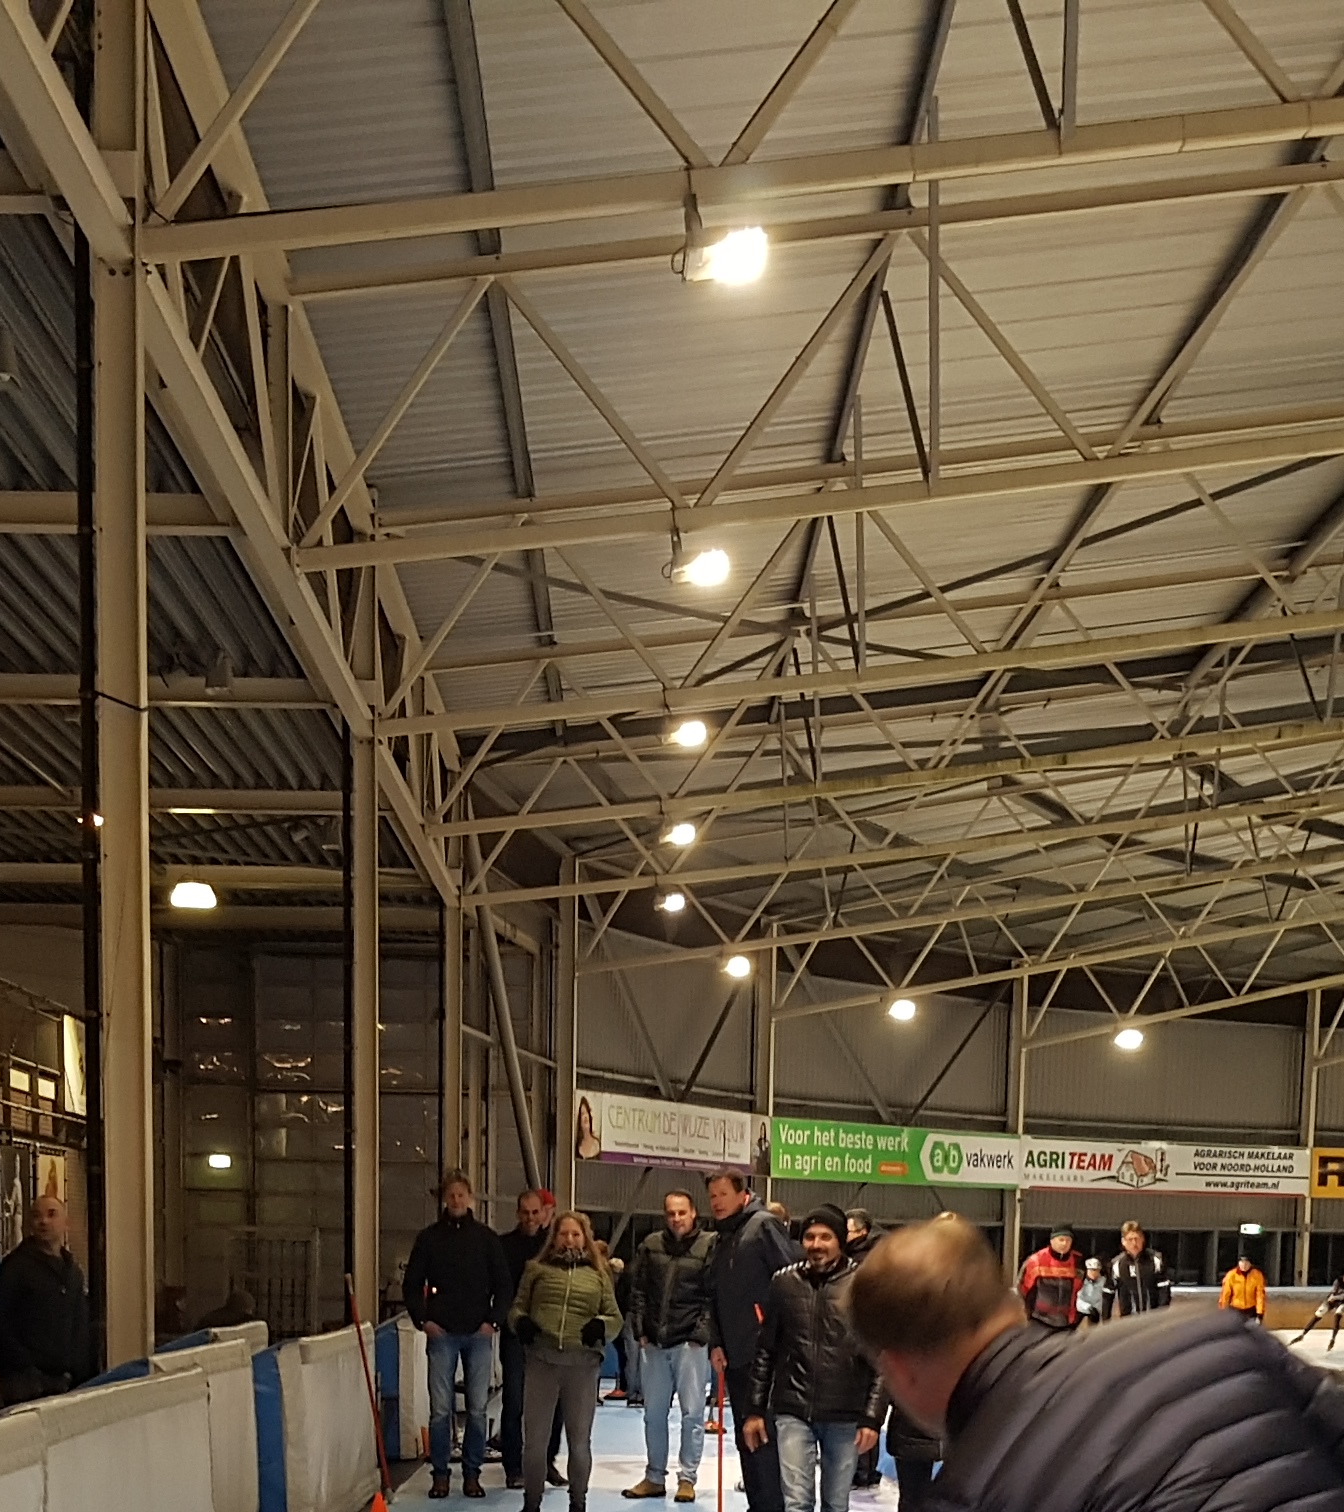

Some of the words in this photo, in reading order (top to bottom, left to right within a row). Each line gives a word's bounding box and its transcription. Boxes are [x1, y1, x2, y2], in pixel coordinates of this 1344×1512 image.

[779, 1123, 810, 1146] Voor
[813, 1126, 835, 1147] het
[838, 1129, 874, 1150] beste
[876, 1133, 909, 1153] werk
[778, 1149, 791, 1169] in
[793, 1151, 822, 1176] agri
[824, 1156, 841, 1172] en
[844, 1154, 872, 1174] food
[965, 1150, 1015, 1169] vakwerk
[1193, 1149, 1246, 1161] AGRARISCH
[1247, 1151, 1295, 1162] MAKELAAR
[1193, 1162, 1218, 1173] VOOR
[1220, 1162, 1295, 1174] NOORD-HOLLAND
[1205, 1180, 1280, 1191] www.agriteam.nl
